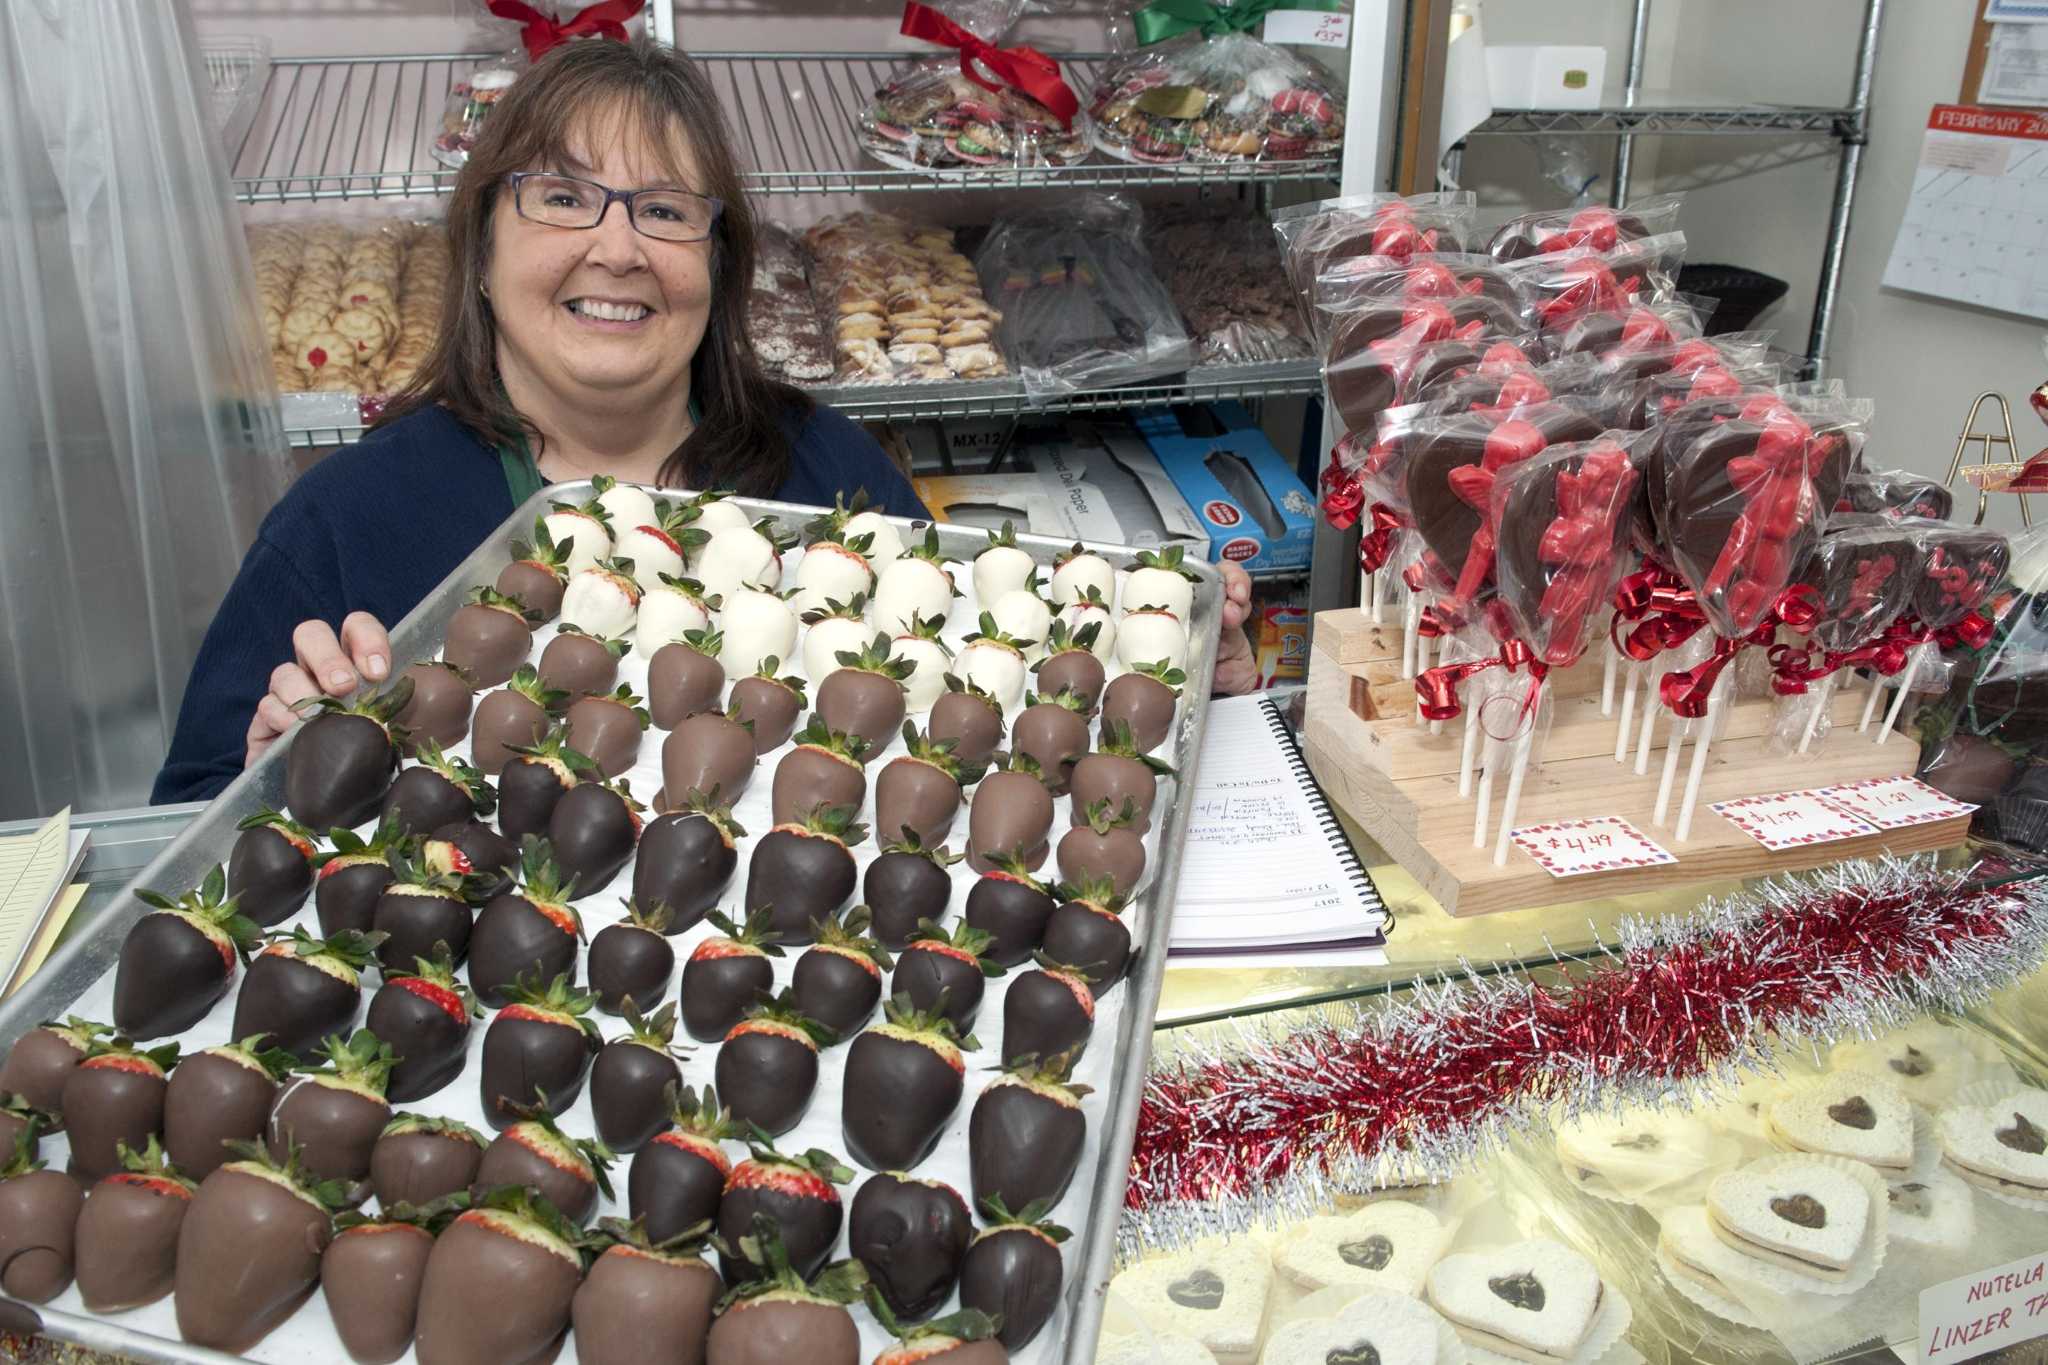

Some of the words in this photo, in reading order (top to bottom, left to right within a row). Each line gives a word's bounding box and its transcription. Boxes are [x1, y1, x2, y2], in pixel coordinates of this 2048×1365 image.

[1937, 111, 2022, 131] FEBRUARY
[1067, 488, 1089, 514] Paper
[1967, 1261, 2045, 1304] NUTELLA
[1927, 1306, 2013, 1357] LINZER
